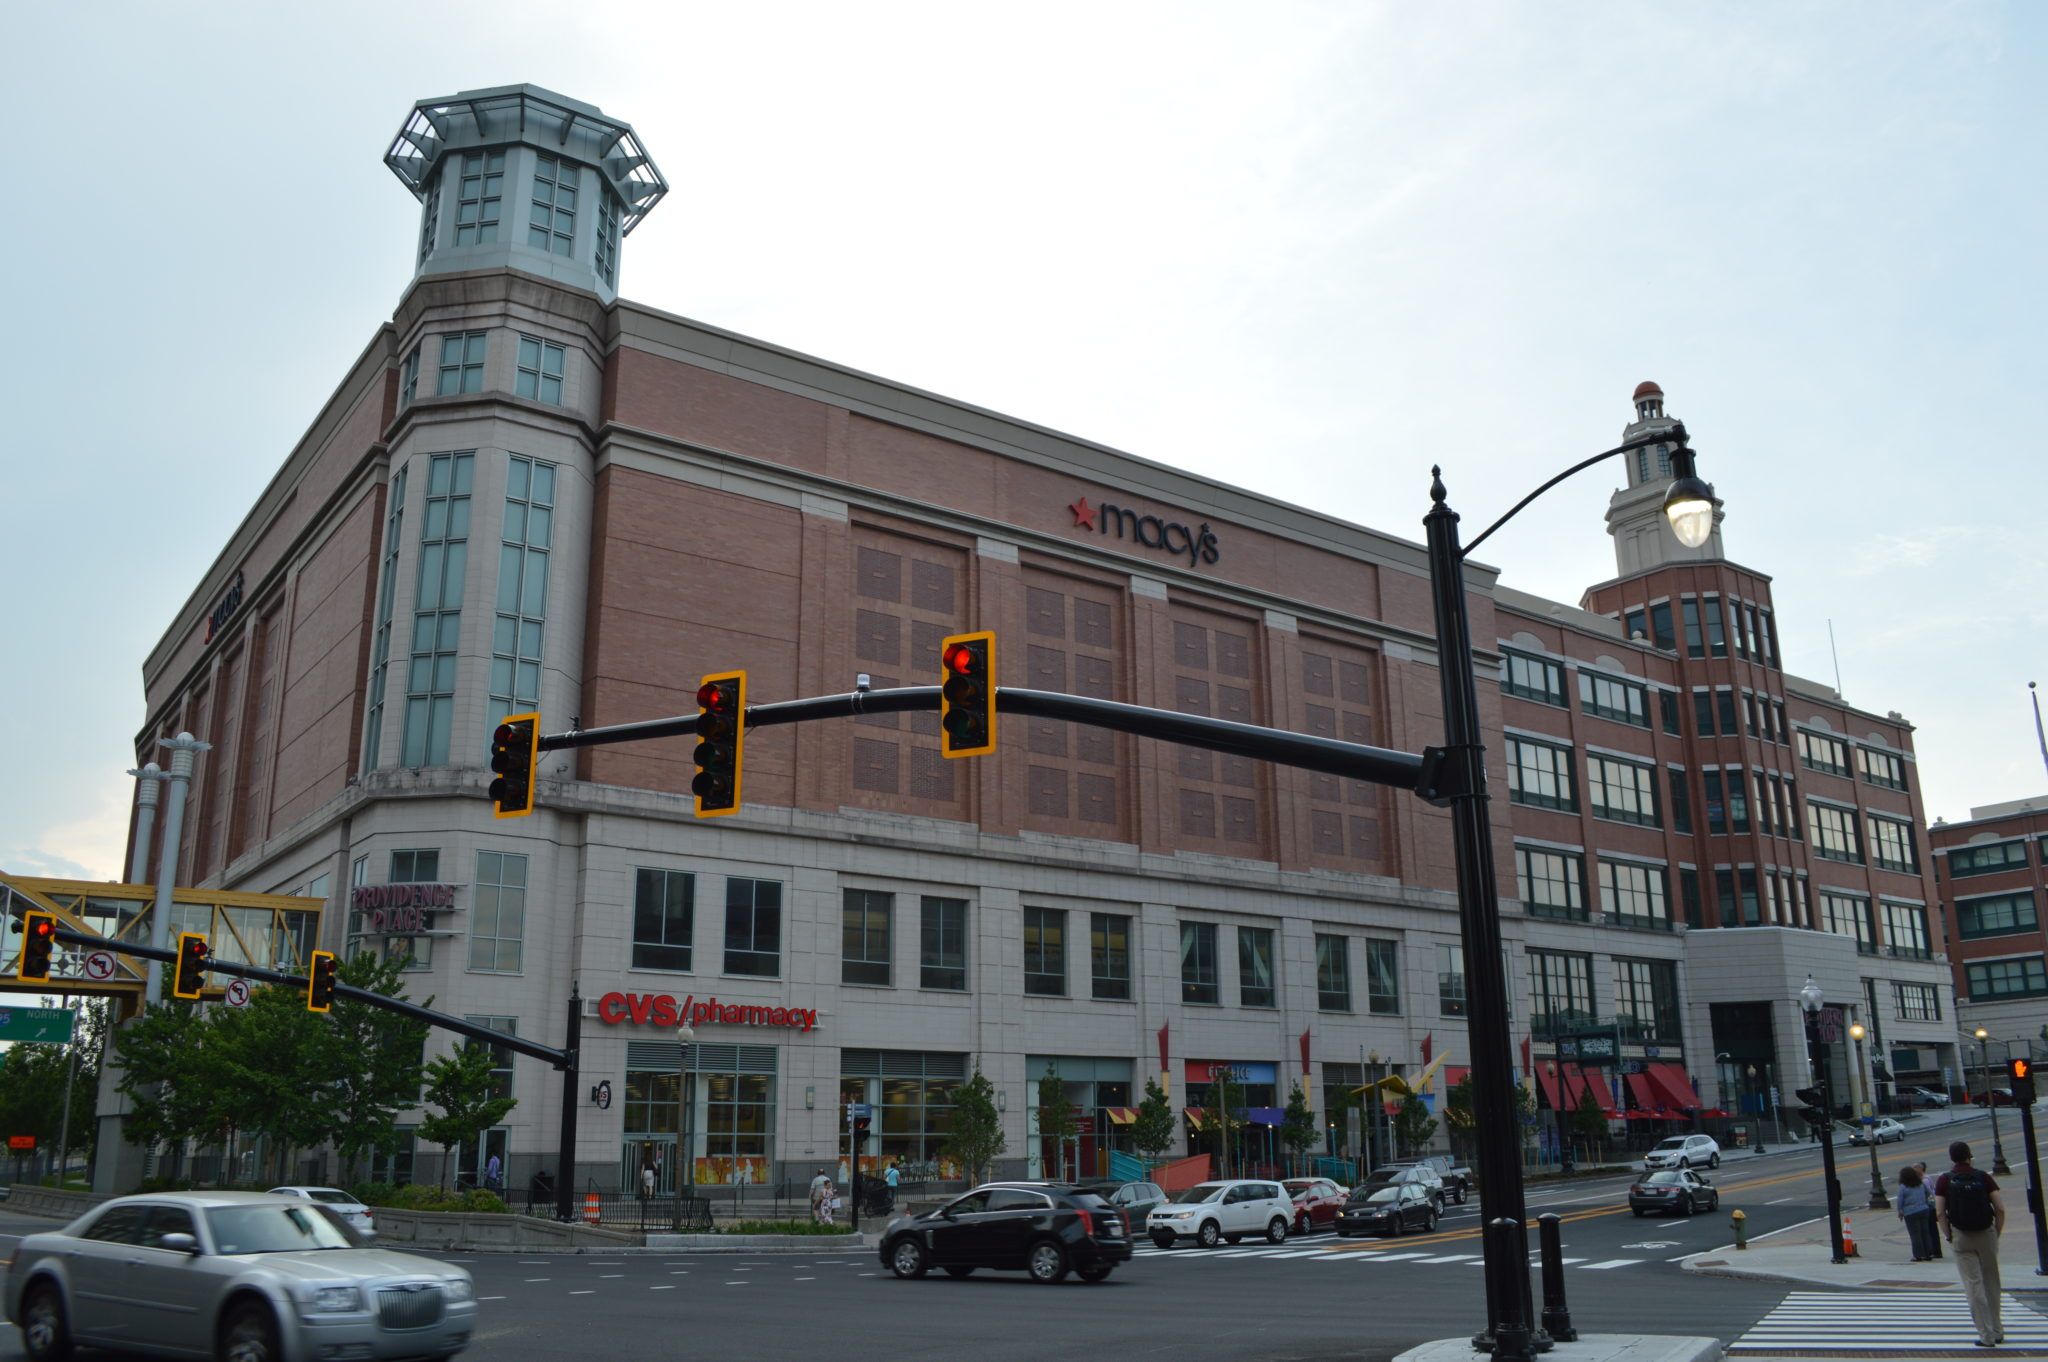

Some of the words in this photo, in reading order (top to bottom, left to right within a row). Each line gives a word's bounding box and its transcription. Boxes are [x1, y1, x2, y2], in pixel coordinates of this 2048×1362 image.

[1101, 503, 1220, 568] macy's
[353, 884, 455, 909] PROVIDENCE
[372, 907, 426, 932] PLACE
[27, 1010, 60, 1020] NORTH
